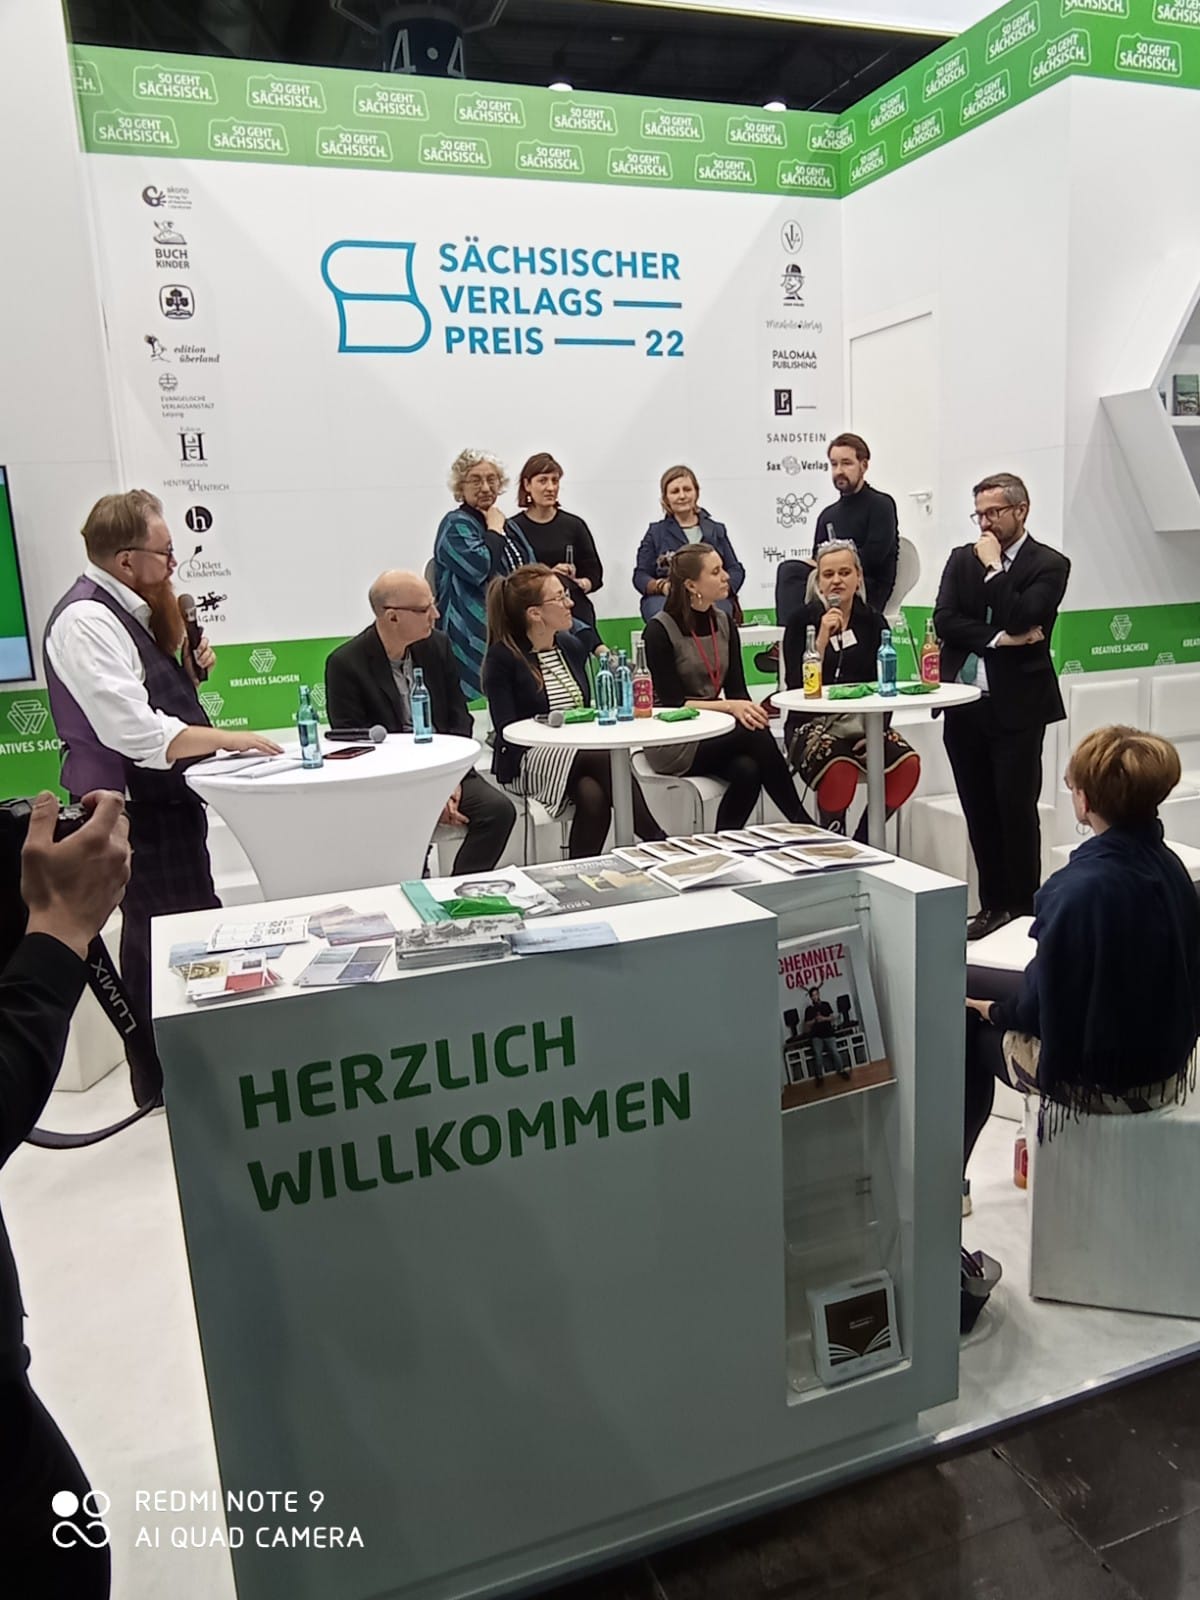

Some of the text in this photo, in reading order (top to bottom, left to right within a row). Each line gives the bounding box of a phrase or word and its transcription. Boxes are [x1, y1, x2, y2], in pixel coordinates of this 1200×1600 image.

[1157, 4, 1200, 24] SÄCHSIS
[1047, 33, 1079, 60] SO GEHT
[1136, 42, 1171, 57] SO GEHT
[1033, 45, 1087, 81] SÄCHSISCH.
[1120, 50, 1178, 73] SÄCHSISCH.
[158, 72, 201, 86] SO GEHT
[138, 80, 213, 100] SÄCHSISCH.
[270, 81, 312, 96] SO GEHT
[251, 91, 322, 109] SÄCHSISCH.
[376, 90, 415, 104] SO GEHT
[358, 99, 424, 117] SÄCHSISCH.
[476, 99, 513, 113] SO GEHT
[570, 107, 605, 120] SO GEHT
[118, 117, 162, 130] SO GEHT
[459, 107, 521, 125] SÄCHSISCH.
[554, 115, 613, 132] SÄCHSISCH.
[660, 114, 692, 127] SO GEHT
[98, 125, 173, 144] SÄCHSISCH.
[231, 124, 273, 138] SO GEHT
[644, 122, 700, 139] SÄCHSISCH.
[745, 121, 776, 133] SO GEHT
[213, 134, 284, 151] SÄCHSISCH.
[339, 132, 378, 146] SO GEHT
[730, 128, 783, 146] SÄCHSISCH.
[321, 140, 388, 158] SÄCHSISCH.
[440, 140, 477, 153] SO GEHT
[536, 146, 572, 159] SO GEHT
[423, 147, 486, 165] SÄCHSISCH.
[520, 153, 580, 171] SÄCHSISCH.
[627, 153, 660, 166] SO GEHT
[612, 161, 668, 177] SÄCHSISCH.
[713, 159, 745, 171] SO GEHT
[795, 165, 825, 177] SO GEHT
[699, 166, 753, 182] SÄCHSISCH.
[781, 172, 832, 187] SÄCHSISCH.
[155, 248, 188, 260] BUCH
[439, 235, 681, 280] SÄCHSISCHER
[156, 260, 190, 269] KINDER
[439, 284, 604, 317] VERLAGS
[444, 326, 684, 357] PREIS 22
[174, 345, 206, 354] edition
[772, 350, 817, 360] PALOMAA
[179, 354, 221, 363] überland
[772, 361, 817, 370] PUBLISHING
[767, 433, 826, 444] SANDSTEIN
[767, 461, 829, 472] Sax Verlag
[202, 559, 222, 569] Klett
[187, 569, 231, 579] Kinderbuch
[1091, 644, 1122, 656] KREATIVES
[230, 674, 300, 687] KREATIVES SACHSEN
[216, 717, 249, 727] SACHSEN
[0, 738, 66, 755] ATIVES SACH
[785, 962, 843, 989] CAPITAL
[90, 958, 137, 1034] LUMIX
[239, 1015, 576, 1129] HERZLICH
[246, 1071, 691, 1212] WILLKOMMEN
